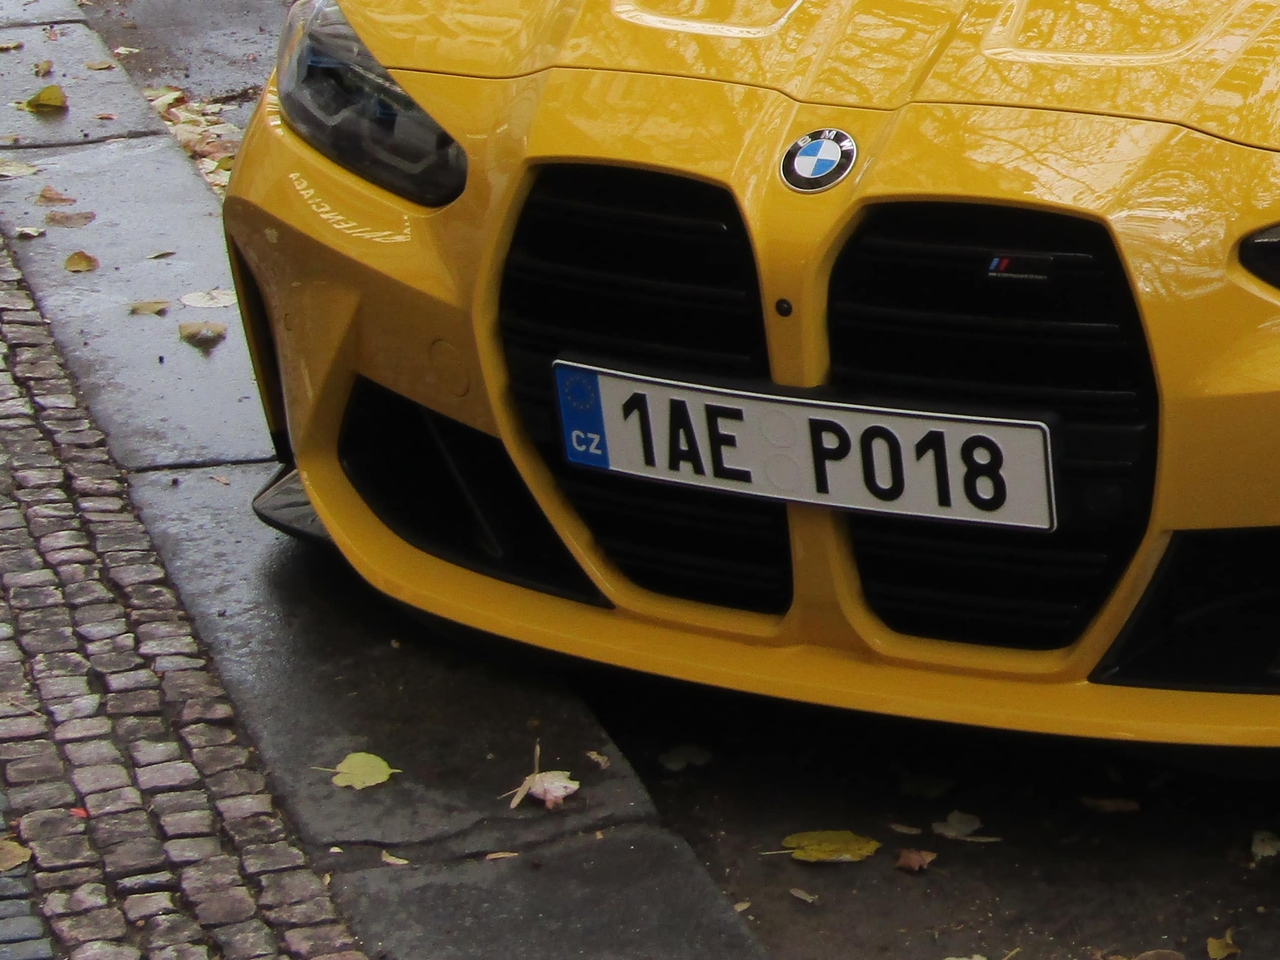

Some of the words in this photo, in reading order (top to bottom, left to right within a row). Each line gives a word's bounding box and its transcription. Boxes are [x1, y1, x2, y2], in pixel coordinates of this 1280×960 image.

[797, 130, 854, 151] BMW
[572, 430, 602, 455] CZ
[622, 392, 752, 483] 1AE
[808, 417, 1007, 512] P018
